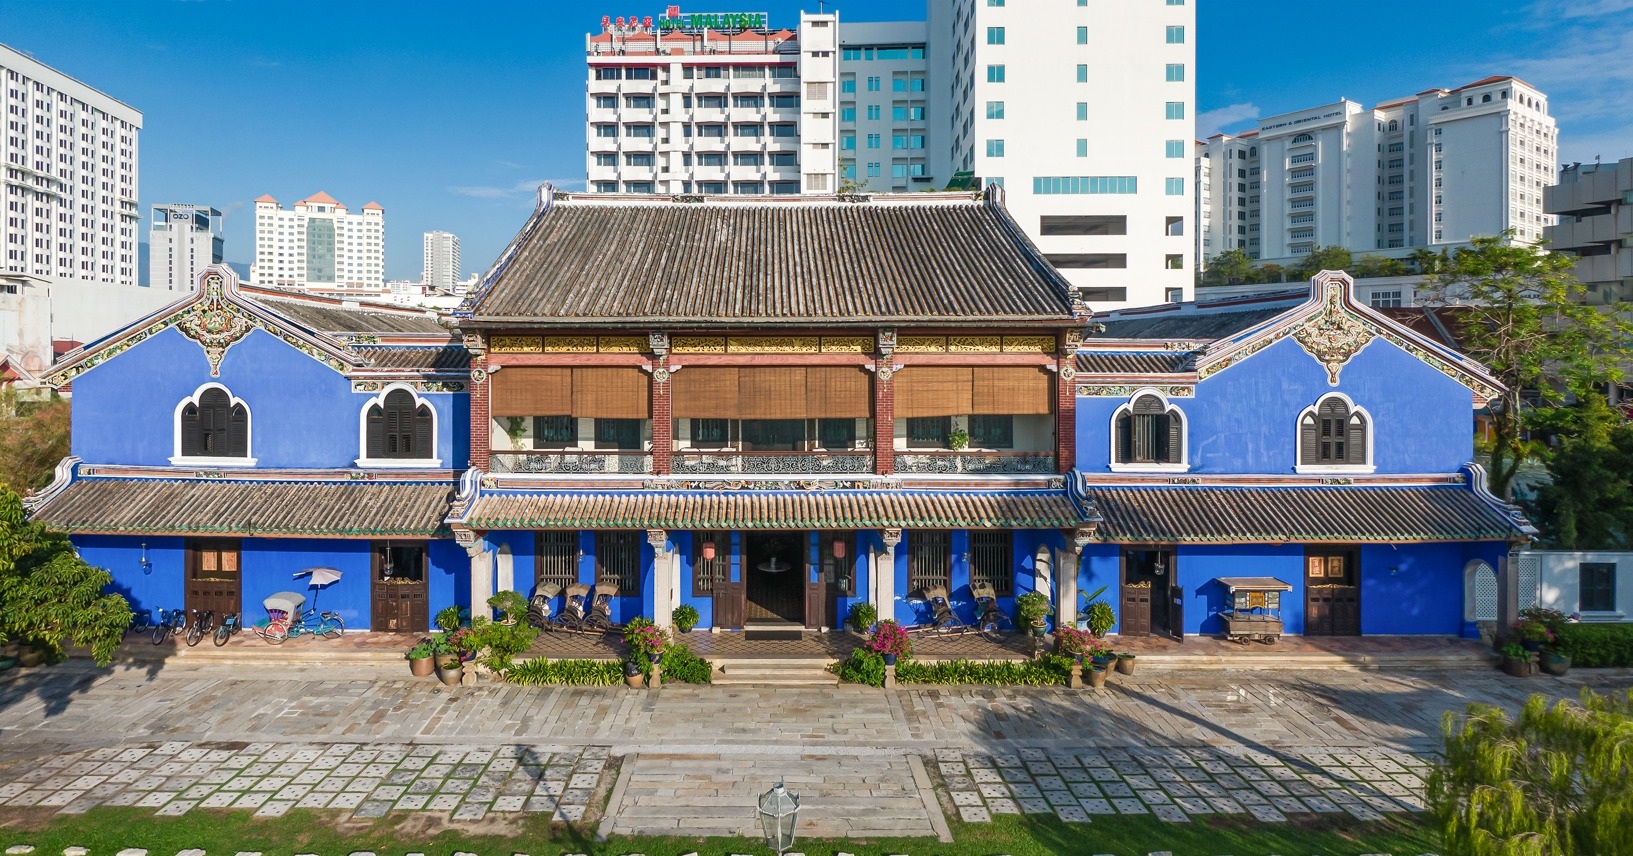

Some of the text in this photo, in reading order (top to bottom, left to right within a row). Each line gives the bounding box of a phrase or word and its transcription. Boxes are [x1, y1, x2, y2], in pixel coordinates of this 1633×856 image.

[659, 19, 686, 29] HOTEL
[690, 13, 763, 29] MALAYSIA
[1294, 116, 1321, 124] ORIENTAL
